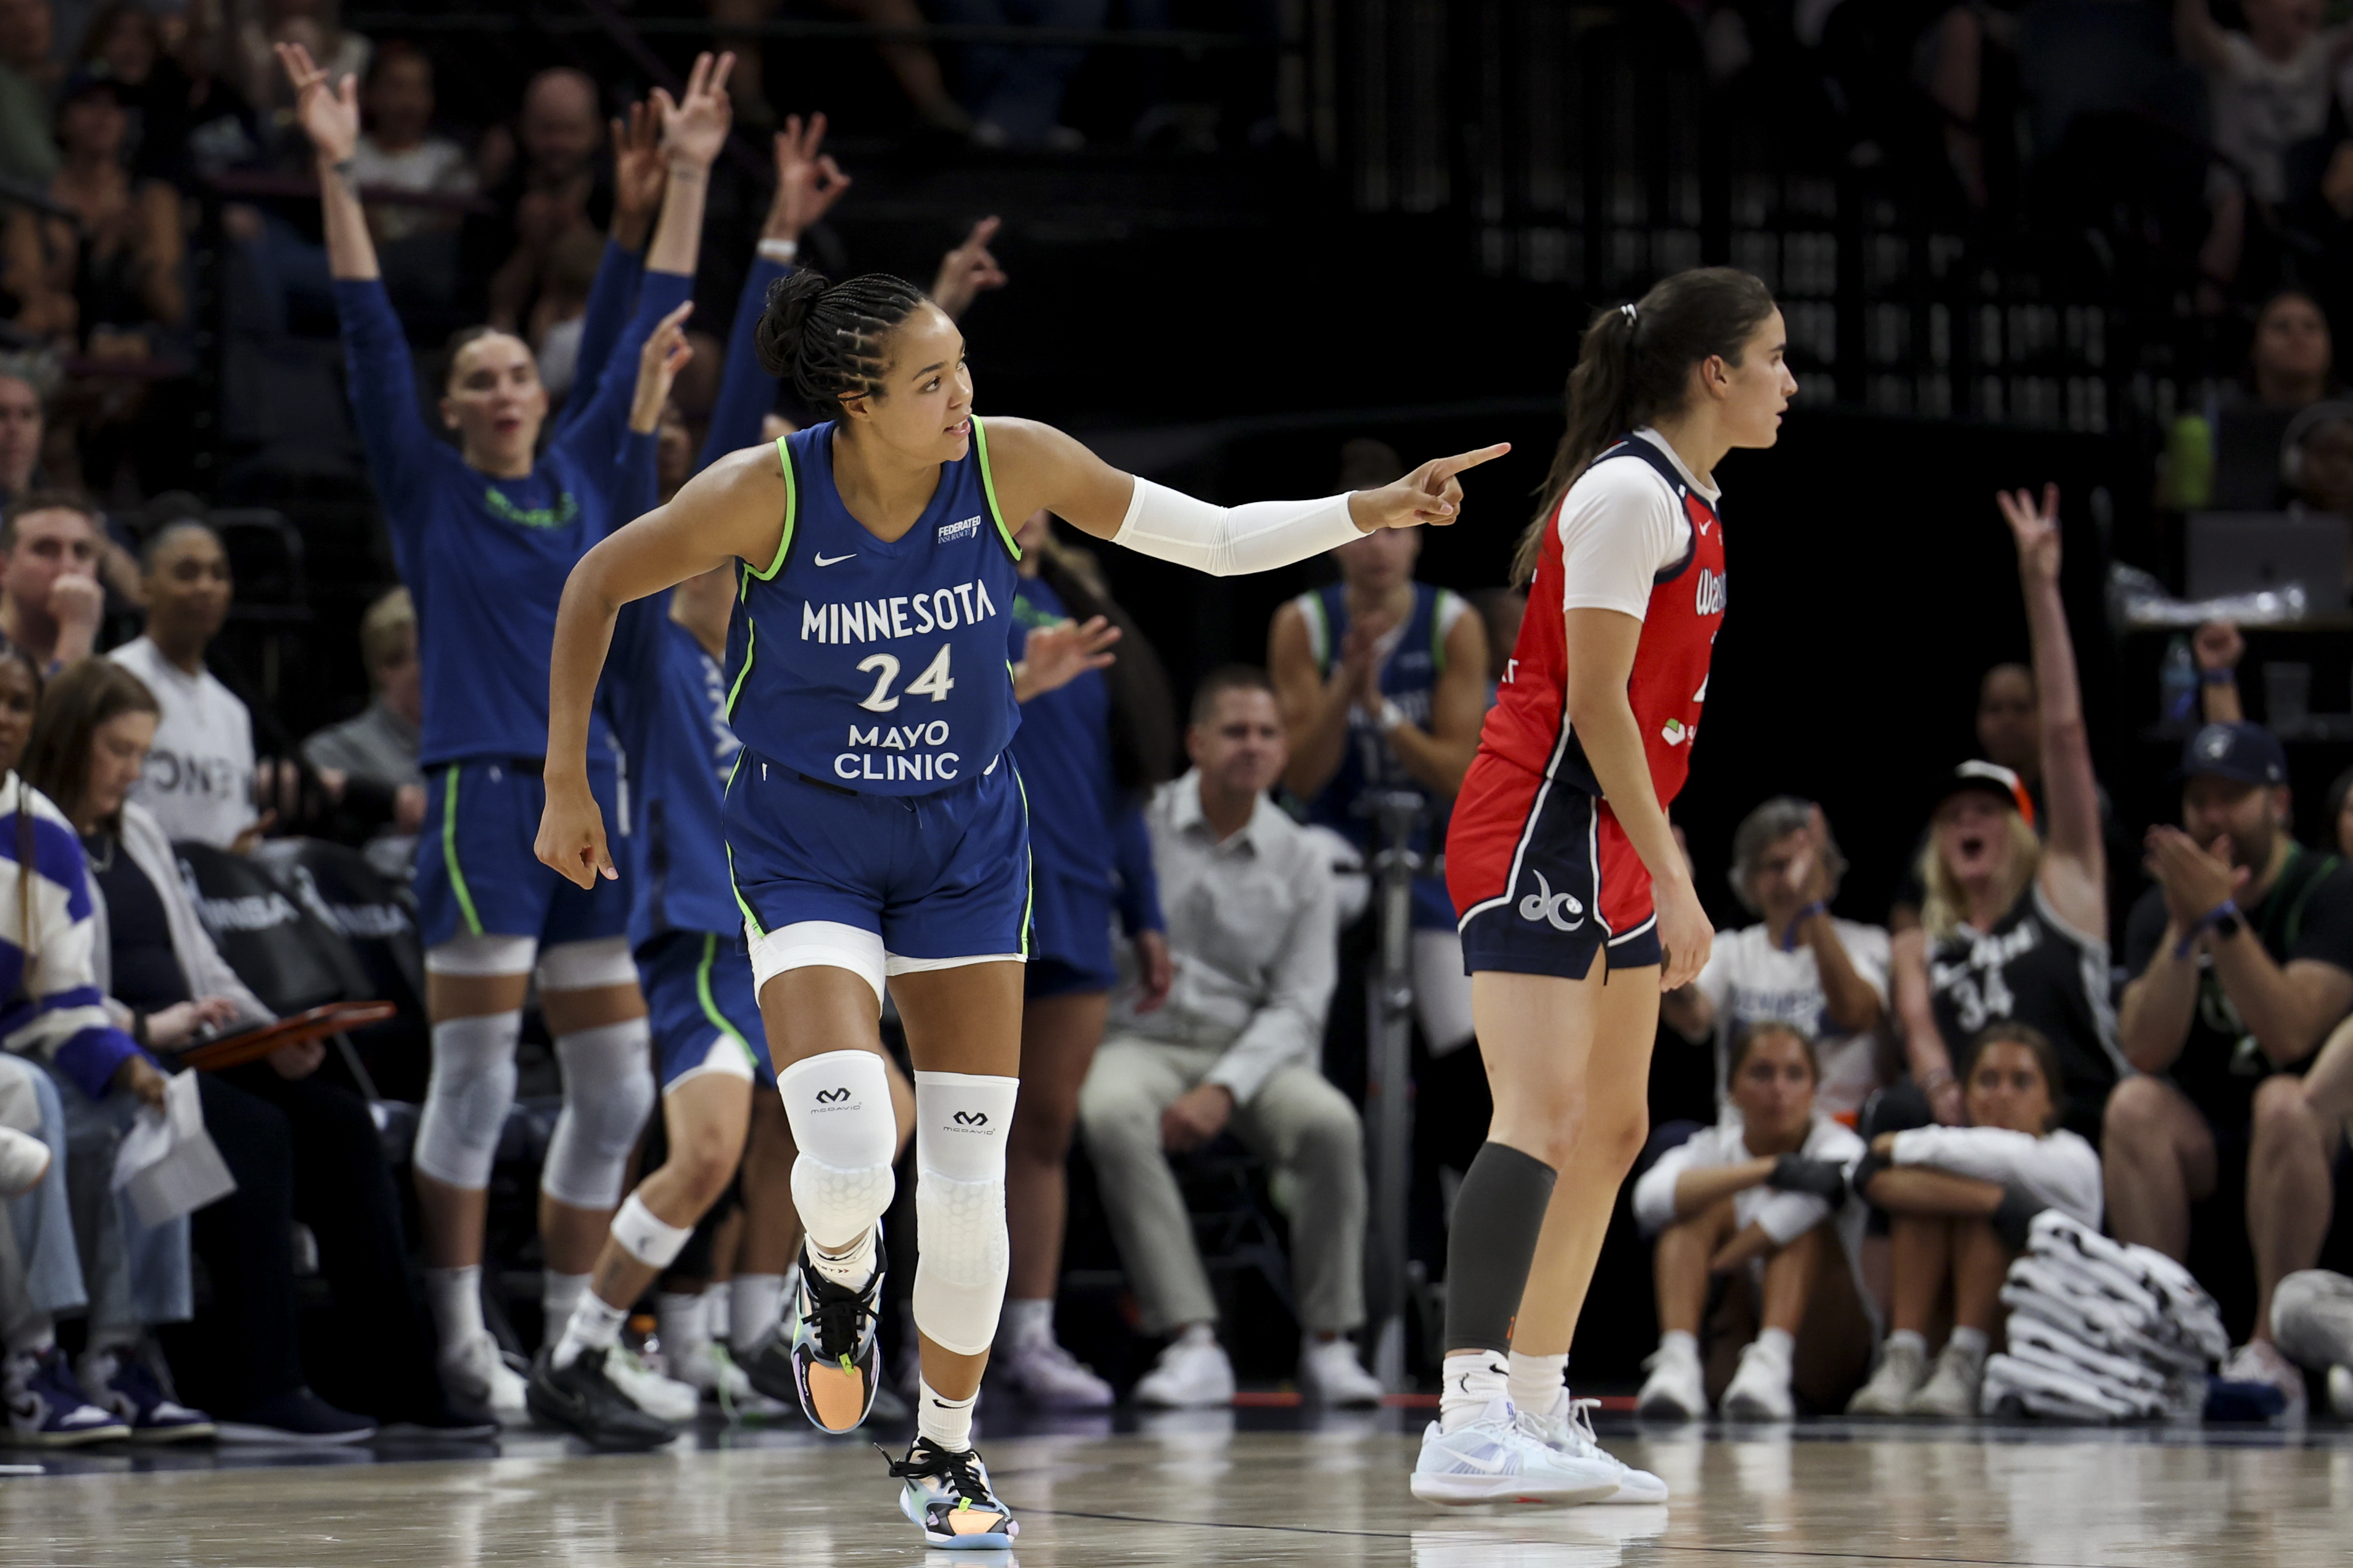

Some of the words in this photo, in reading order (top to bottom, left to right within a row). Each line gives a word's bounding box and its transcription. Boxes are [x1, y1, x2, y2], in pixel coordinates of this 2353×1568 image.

[938, 515, 981, 538] FEDERATED
[938, 528, 972, 544] INSURANCE
[801, 578, 997, 644] MINNESOTA
[856, 643, 955, 712] 24
[848, 720, 950, 751] MAYO
[834, 752, 960, 781] CLINIC
